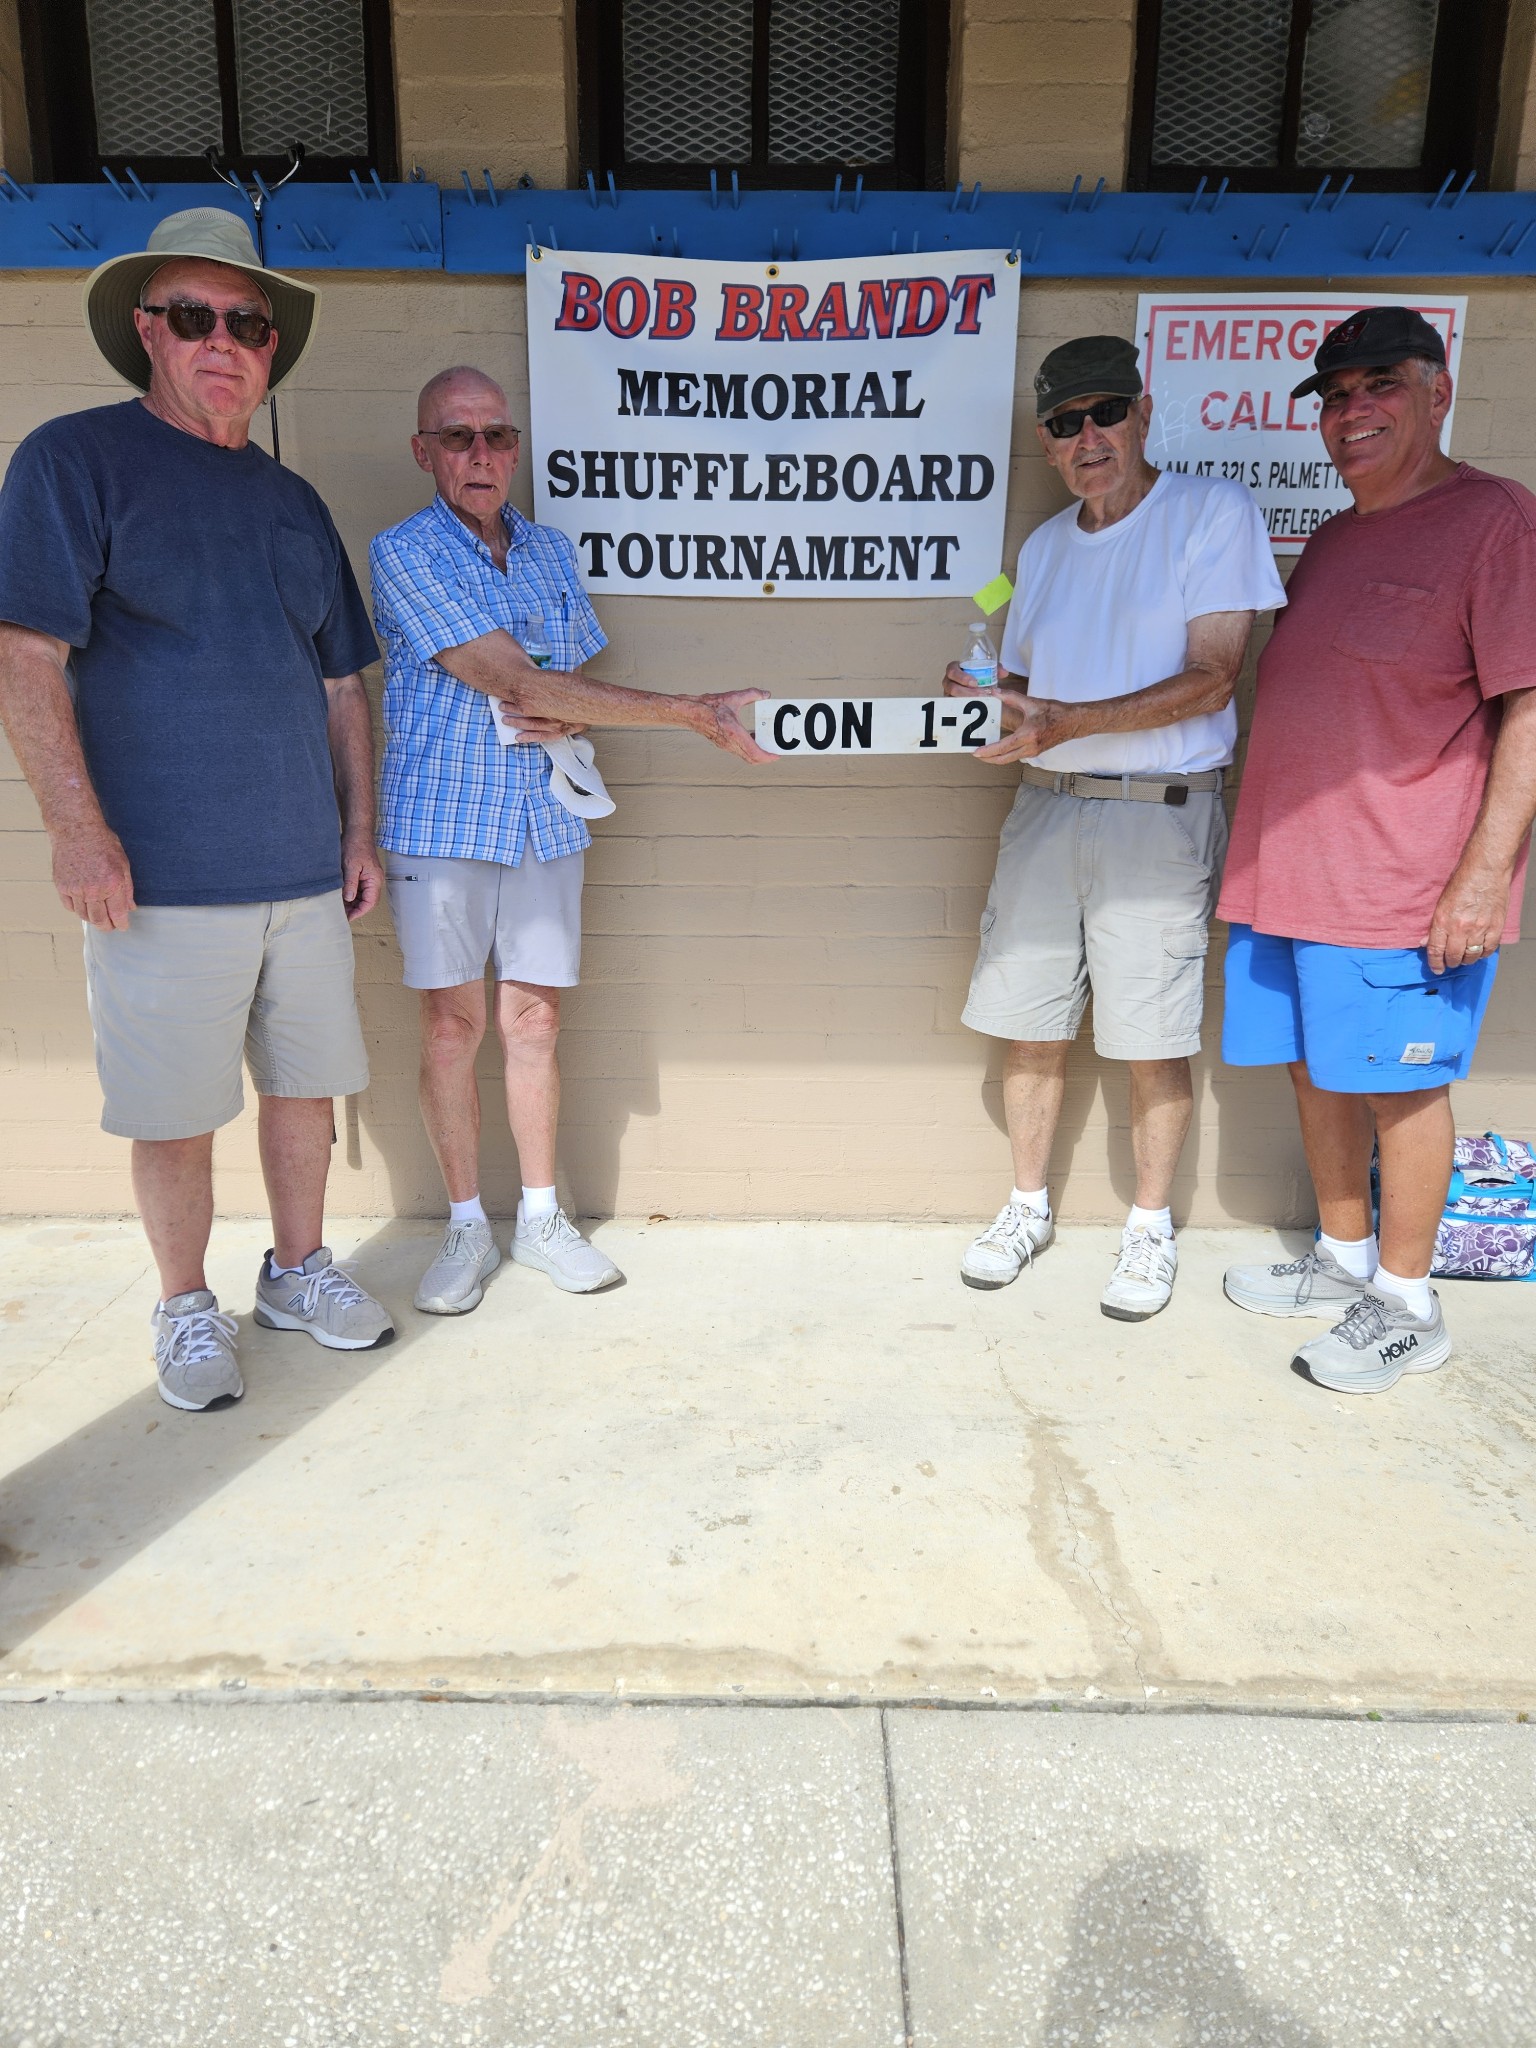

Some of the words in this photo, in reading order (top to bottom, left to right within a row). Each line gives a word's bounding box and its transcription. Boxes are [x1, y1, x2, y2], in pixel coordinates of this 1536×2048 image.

[554, 270, 697, 341] BOB
[714, 273, 996, 342] BRANDT
[617, 368, 926, 421] MEMORIAL
[1200, 390, 1320, 432] CALL:
[547, 449, 995, 503] SHUFFLEBOARD
[1249, 461, 1262, 489] S.
[1267, 461, 1350, 490] PALMET
[578, 531, 961, 582] TOURNAMENT
[773, 701, 873, 750] CON
[919, 700, 989, 748] 1-2
[1365, 1293, 1386, 1308] HOKA
[1378, 1333, 1419, 1366] HOKA
